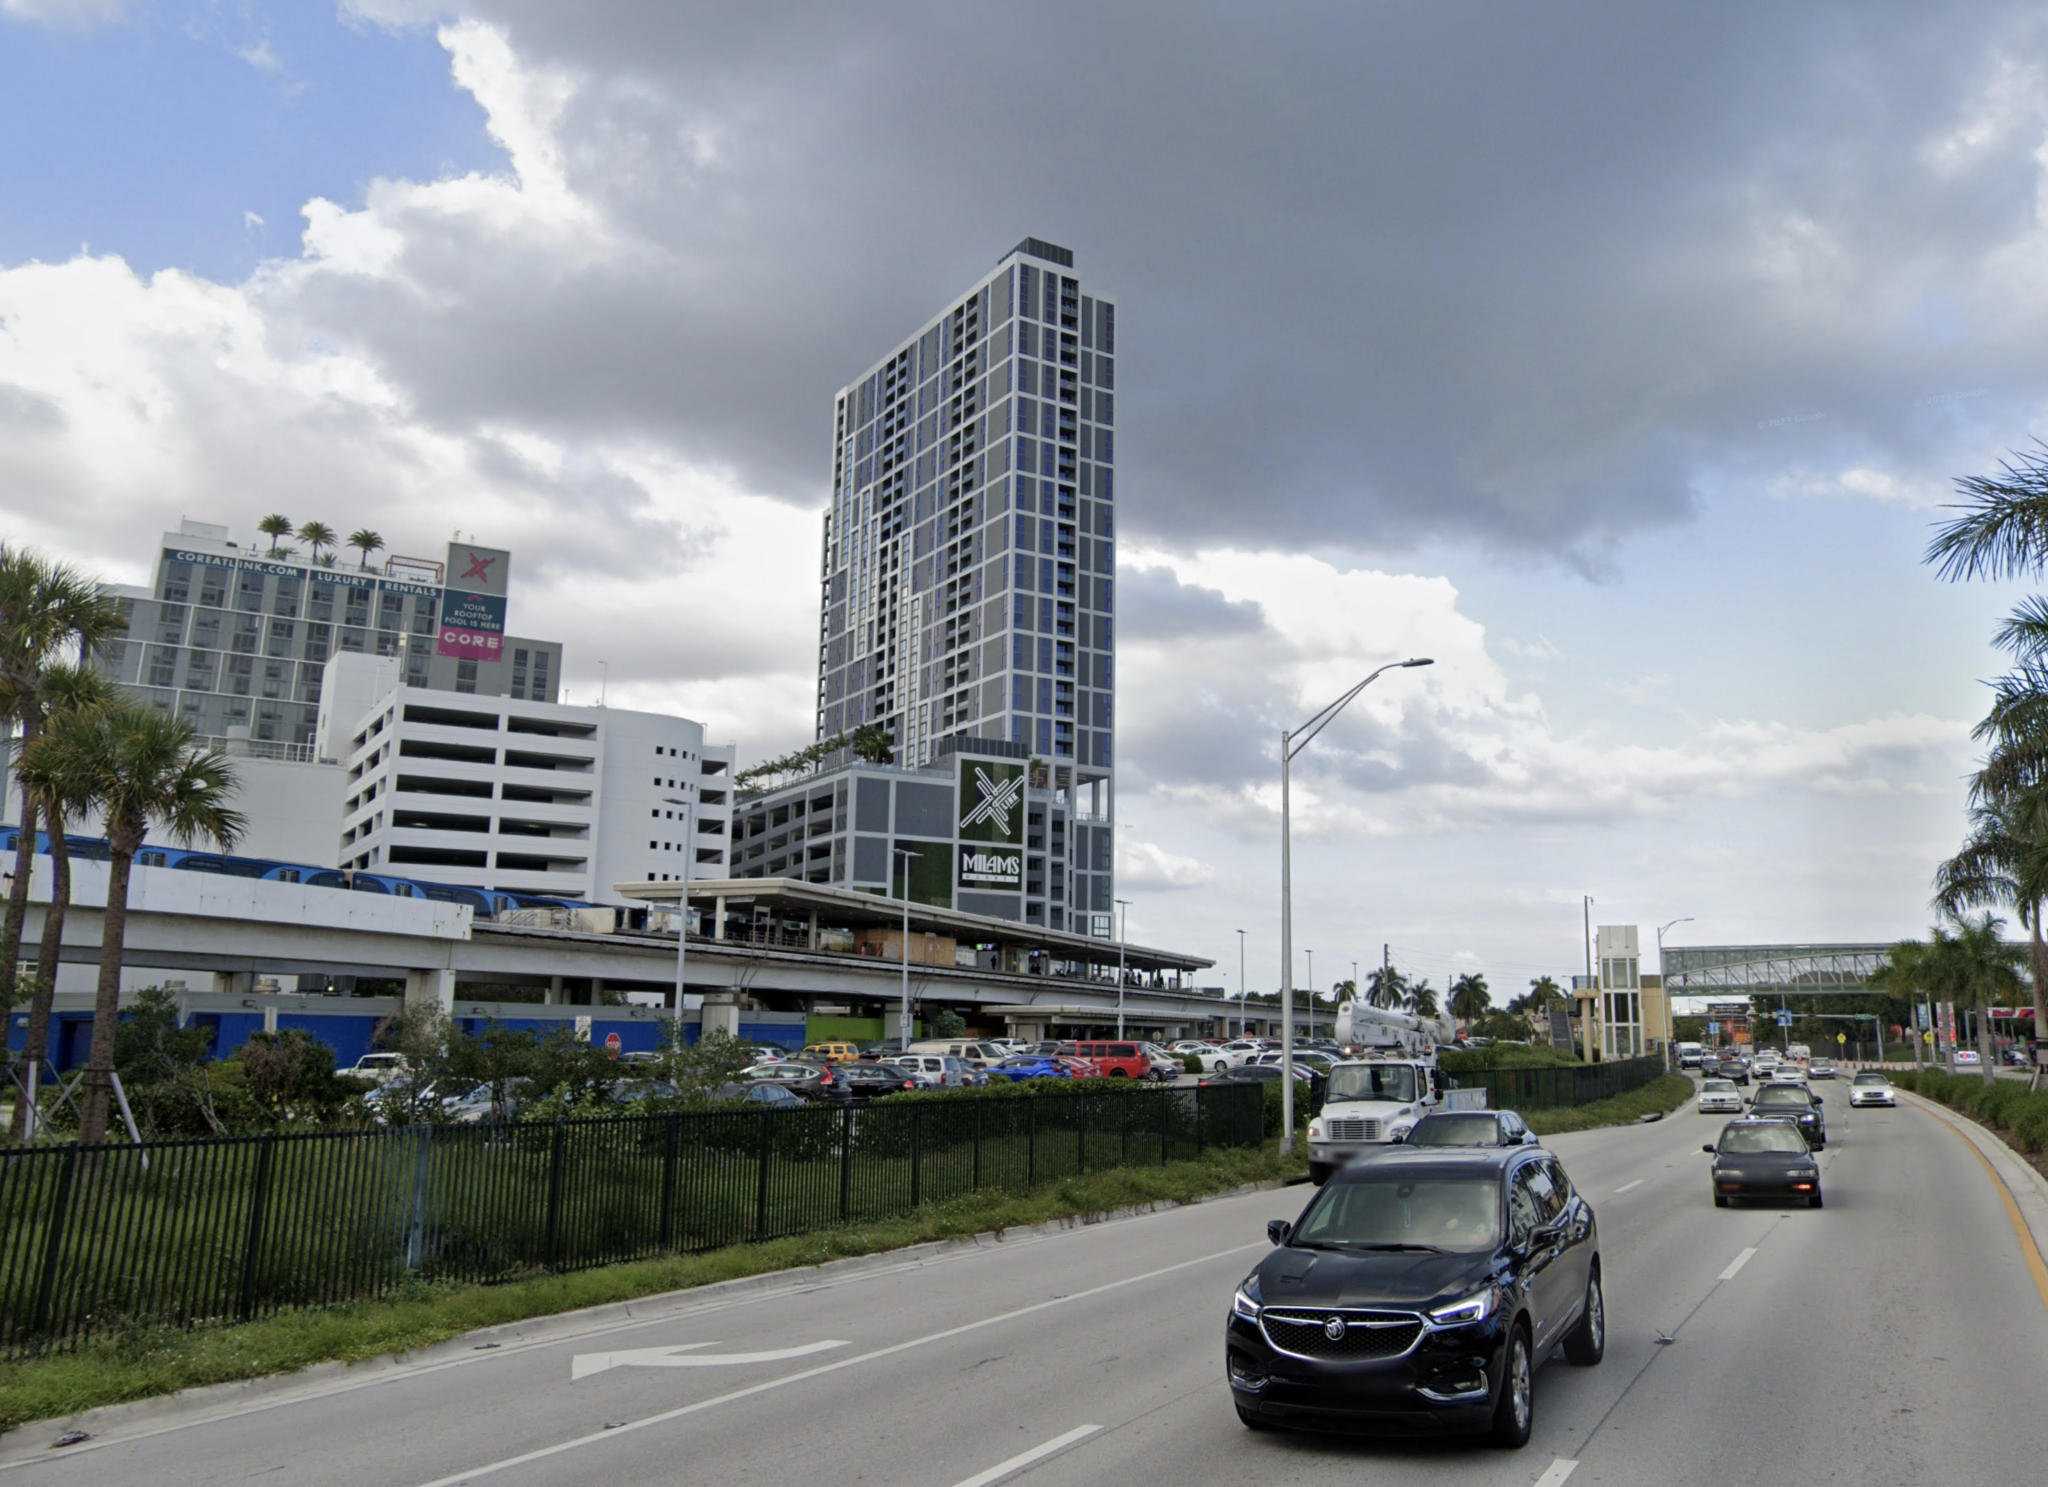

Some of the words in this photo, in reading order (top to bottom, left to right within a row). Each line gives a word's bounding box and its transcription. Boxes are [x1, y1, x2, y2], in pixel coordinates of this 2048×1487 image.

[176, 551, 298, 577] COREATLINK.COM
[318, 572, 368, 587] LUXURY
[385, 581, 437, 597] RENTALS
[454, 609, 493, 621] ROOFTOP
[463, 602, 486, 612] YOUR
[445, 616, 468, 626] POOL
[480, 621, 501, 630] HERE
[443, 631, 499, 649] CORE
[1001, 792, 1019, 810] LINK
